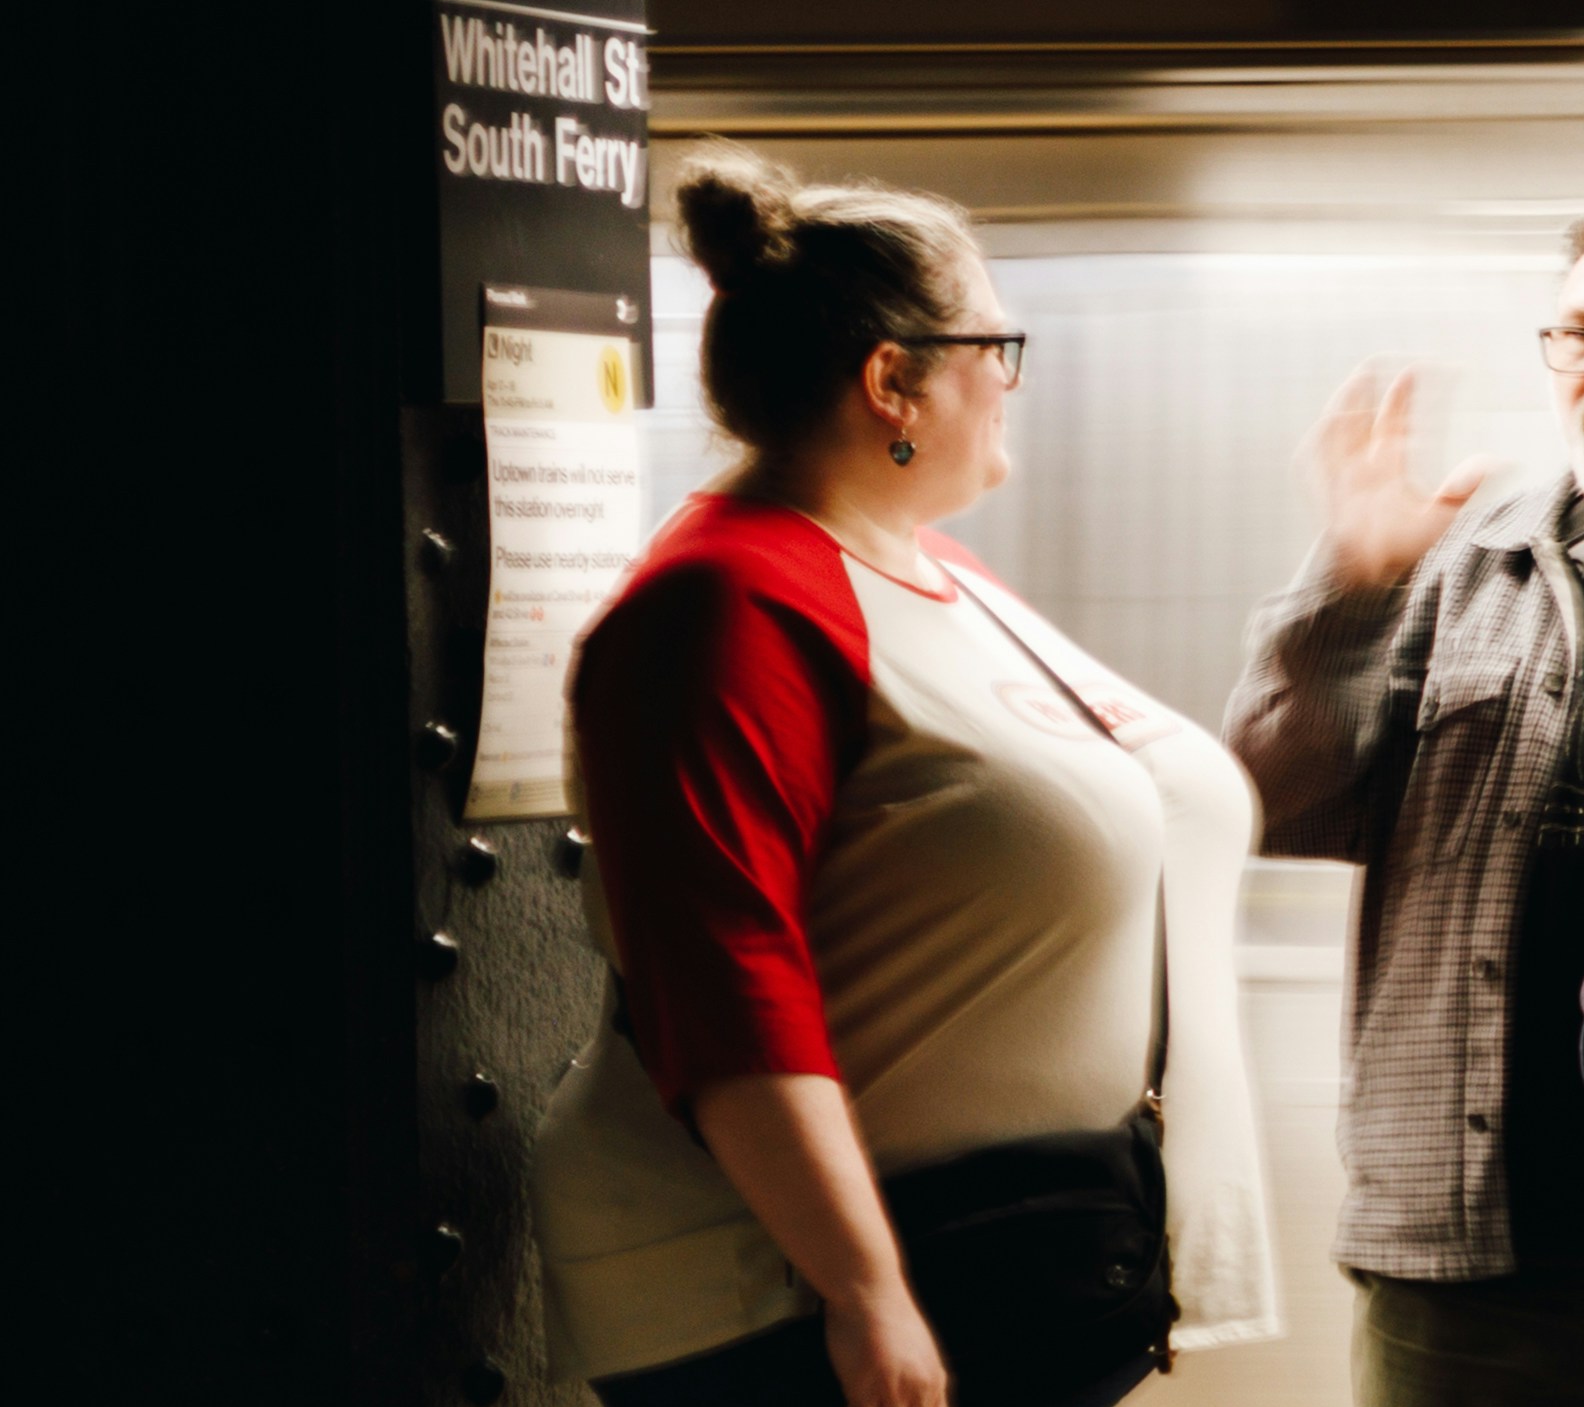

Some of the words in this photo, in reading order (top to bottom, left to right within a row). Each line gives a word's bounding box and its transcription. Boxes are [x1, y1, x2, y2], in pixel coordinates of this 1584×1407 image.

[440, 12, 600, 105] Whitehall
[603, 36, 648, 111] St
[442, 101, 550, 184] South
[555, 116, 647, 210] Ferry
[501, 335, 533, 366] Night
[492, 458, 536, 486] Uptown
[538, 462, 568, 484] trains
